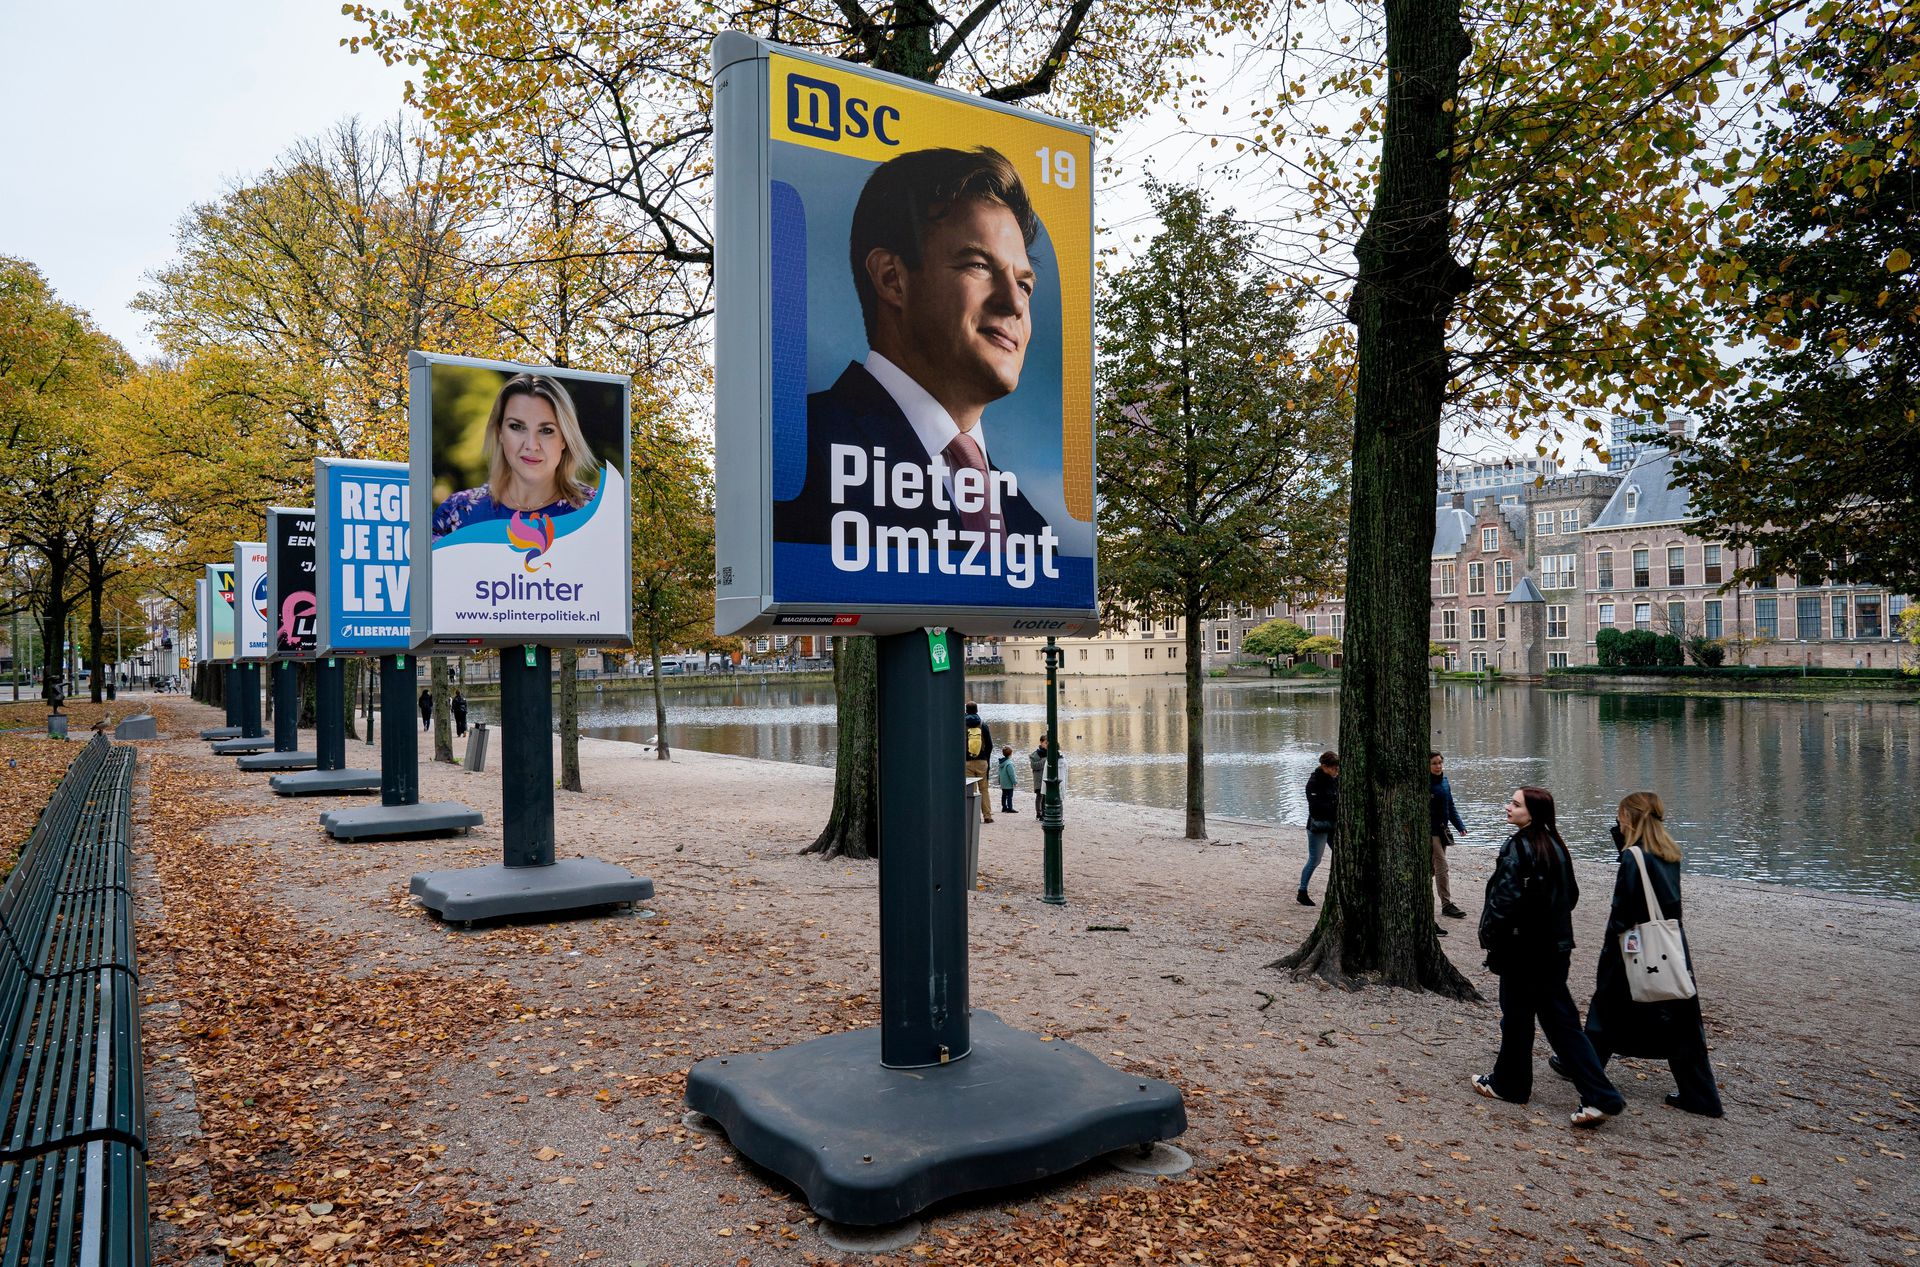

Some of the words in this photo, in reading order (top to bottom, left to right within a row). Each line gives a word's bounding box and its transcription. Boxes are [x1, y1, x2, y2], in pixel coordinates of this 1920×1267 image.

[1035, 146, 1076, 190] 19
[831, 443, 1018, 514] Pieter
[340, 524, 371, 560] JE
[831, 510, 1060, 589] Omtzigt
[342, 564, 410, 612] LEV
[475, 573, 583, 606] splinter
[455, 609, 600, 623] www.splinterpolitiek.nl
